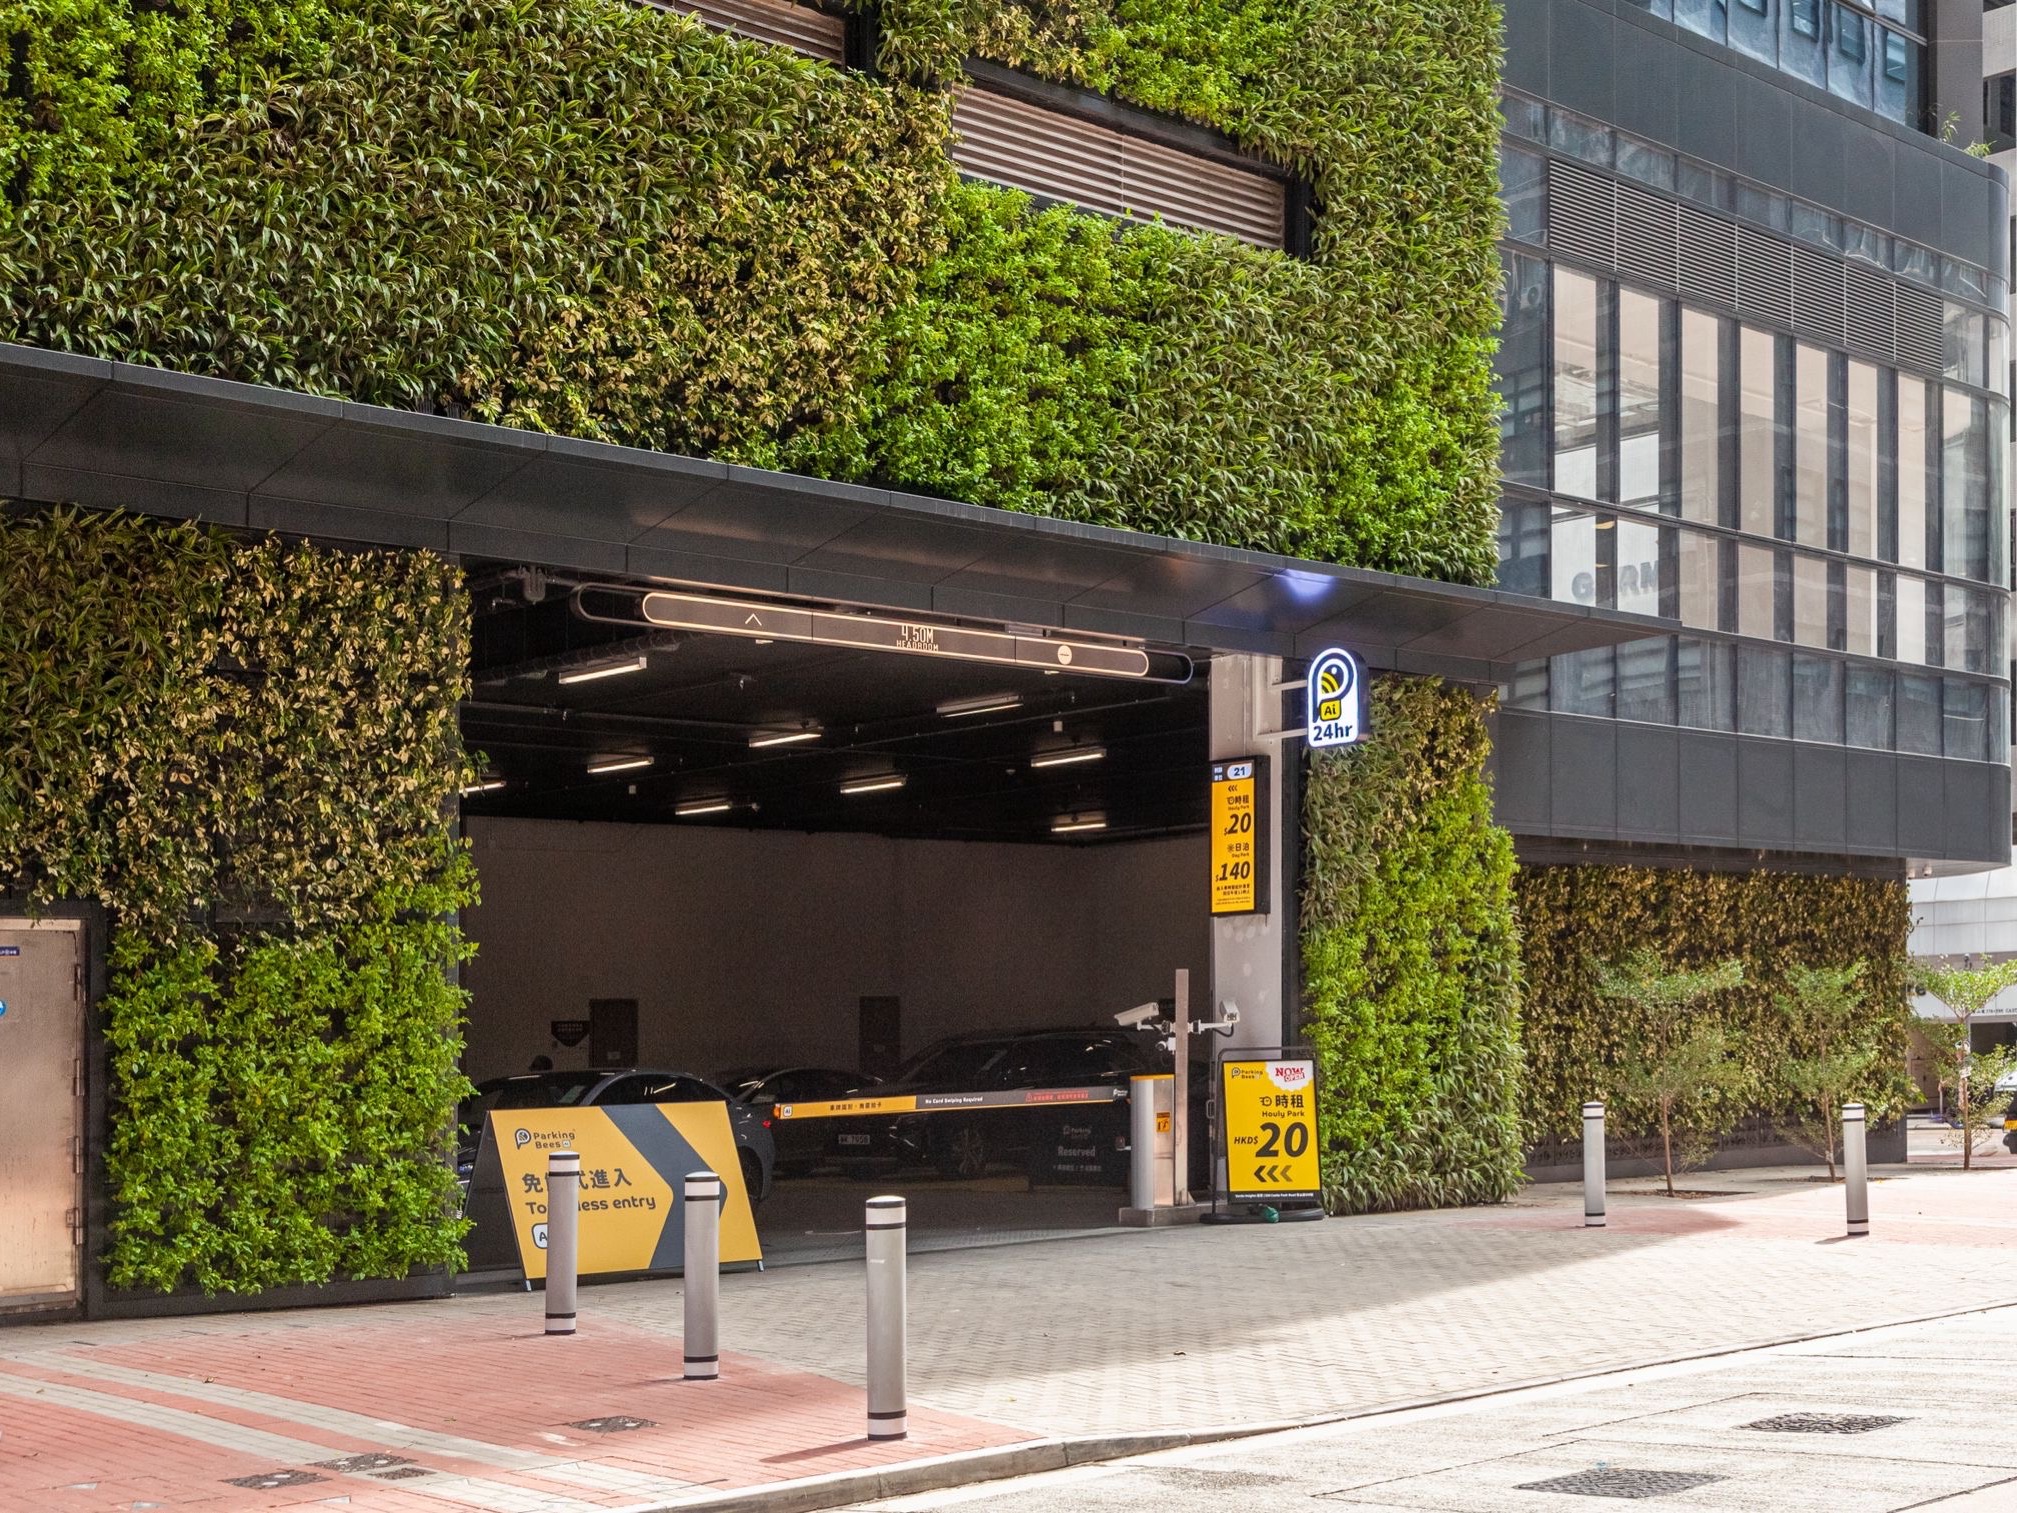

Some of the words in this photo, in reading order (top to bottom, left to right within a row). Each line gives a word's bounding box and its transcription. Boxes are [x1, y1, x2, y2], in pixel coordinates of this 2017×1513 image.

[901, 624, 934, 643] 4.50M
[896, 640, 939, 652] HEADROOM
[1324, 704, 1336, 715] Ai
[1313, 723, 1352, 741] 24hr
[1233, 766, 1246, 776] 21
[1275, 1094, 1304, 1108] 時租
[533, 1130, 576, 1142] Parking
[1234, 1136, 1259, 1145] HKD$
[1255, 1122, 1308, 1158] 20
[535, 1140, 562, 1149] Bees
[1058, 1146, 1095, 1157] Reserved
[521, 1168, 632, 1194] 免進入
[525, 1198, 608, 1215] Toless
[613, 1195, 656, 1210] entry
